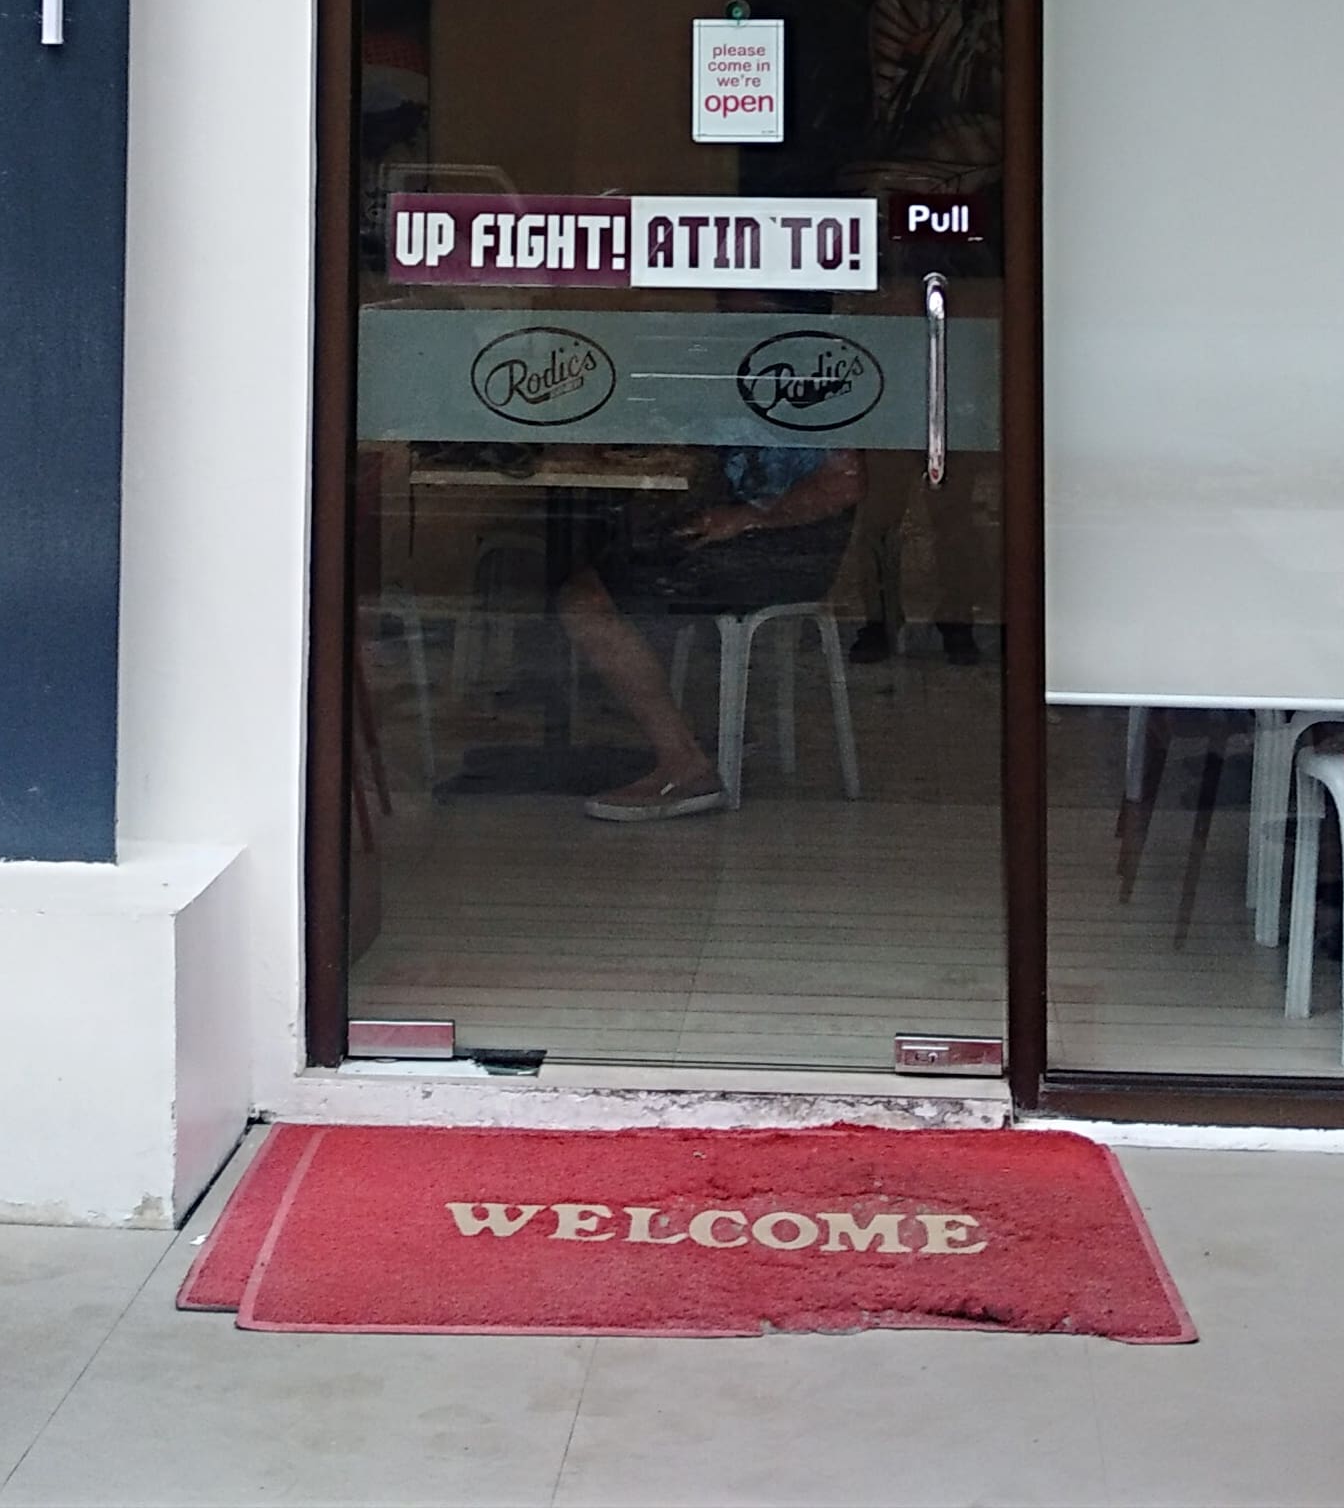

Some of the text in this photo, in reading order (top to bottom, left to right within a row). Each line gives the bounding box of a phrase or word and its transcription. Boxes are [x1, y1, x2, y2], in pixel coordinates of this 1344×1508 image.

[712, 43, 767, 60] please
[707, 58, 771, 73] come in
[716, 73, 762, 88] we're
[704, 94, 775, 120] open
[908, 204, 969, 233] Pull
[395, 211, 456, 267] UP
[470, 212, 626, 271] FIGHT!
[484, 340, 598, 408] Rodic's
[444, 1200, 990, 1255] WELCOME
